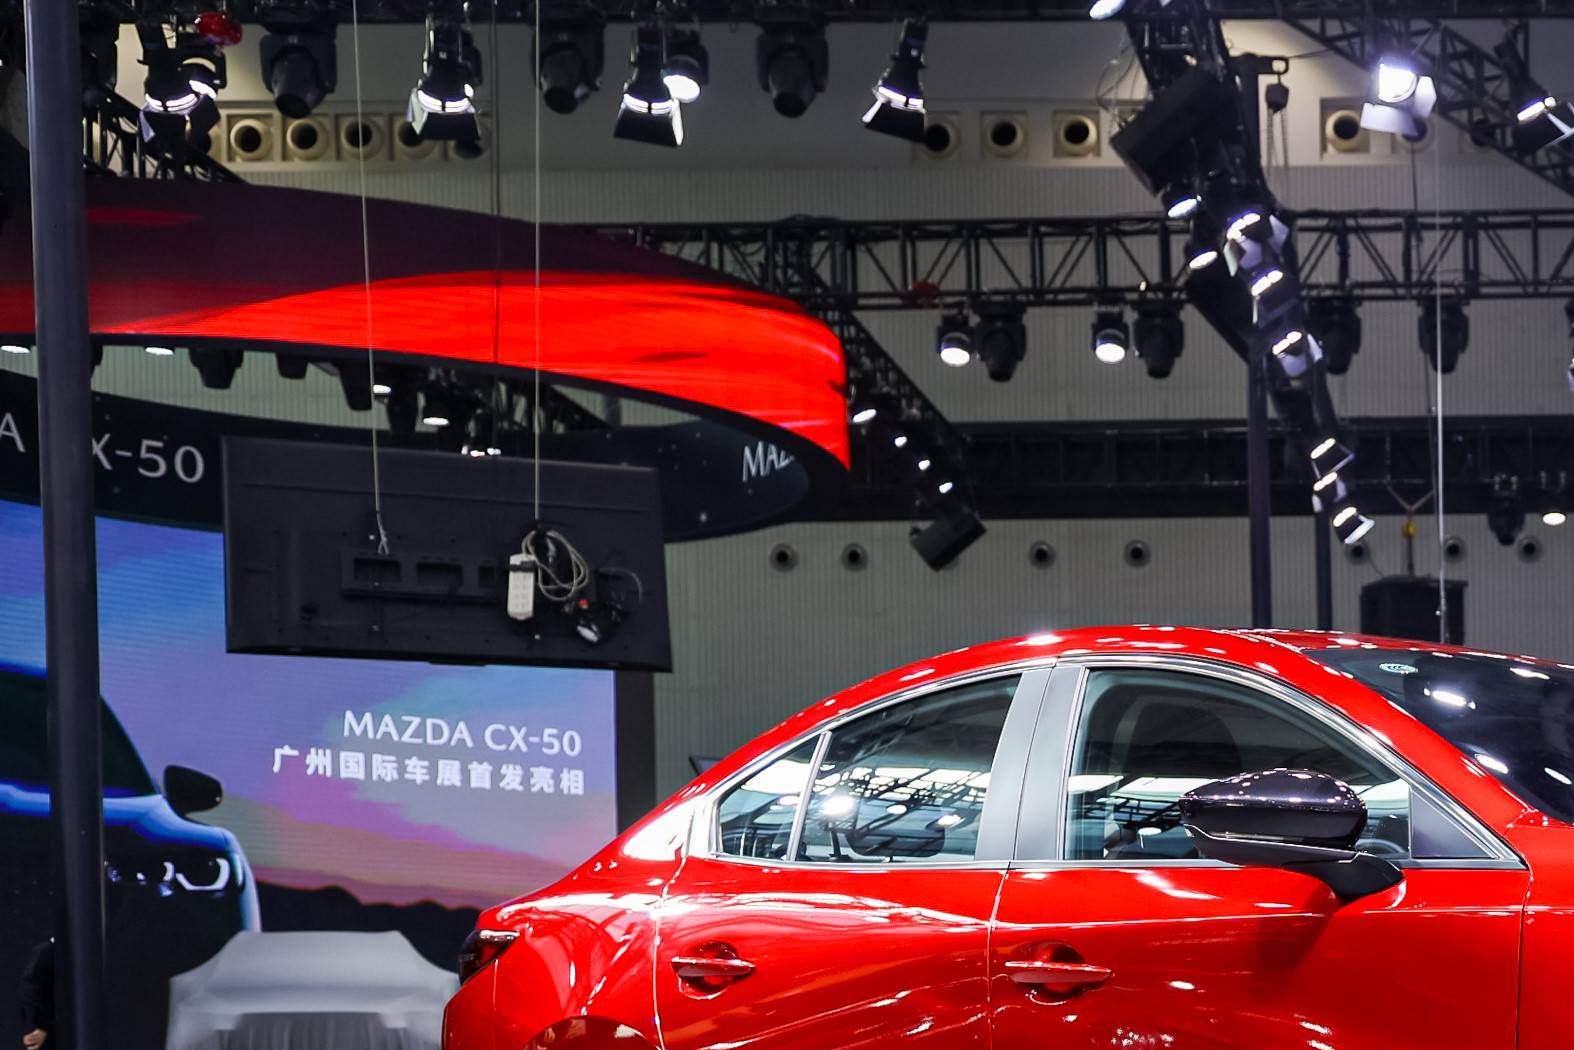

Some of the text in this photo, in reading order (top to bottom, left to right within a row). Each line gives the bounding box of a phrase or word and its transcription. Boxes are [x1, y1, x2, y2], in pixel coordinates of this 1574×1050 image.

[91, 433, 205, 483] X-50
[343, 710, 582, 758] MAZDA CX-50
[272, 744, 585, 795] 广州国际车展首发亮相
